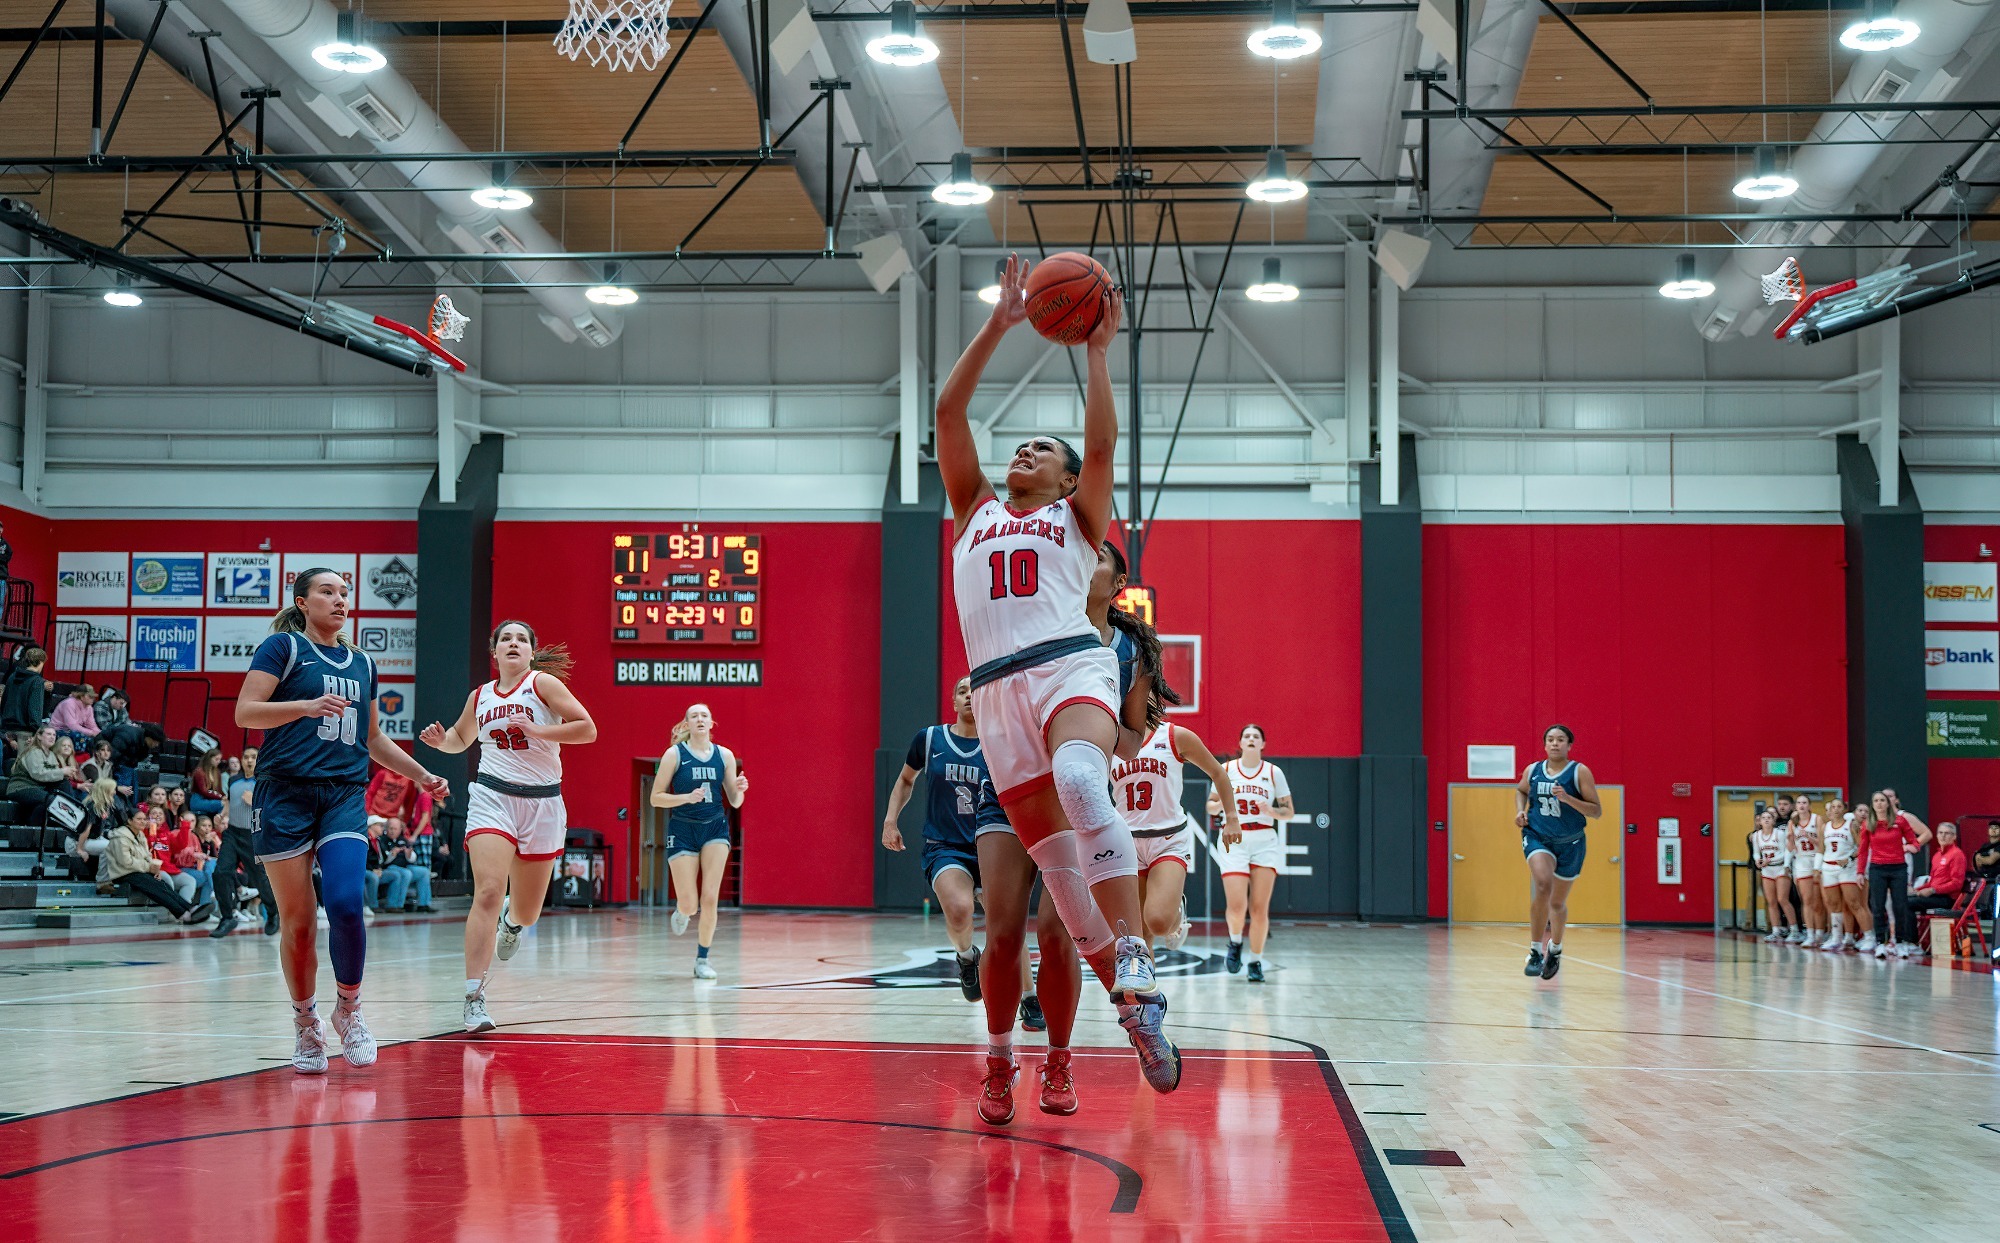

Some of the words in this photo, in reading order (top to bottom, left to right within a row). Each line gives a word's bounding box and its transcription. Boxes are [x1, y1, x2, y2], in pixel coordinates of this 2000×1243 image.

[969, 518, 1066, 553] RAIDERS
[669, 534, 719, 559] 9:31
[743, 550, 759, 575] 9
[76, 571, 125, 582] ROGUE
[217, 568, 262, 596] 12
[672, 574, 699, 586] period
[708, 569, 720, 588] 2
[989, 549, 1038, 600] 10
[622, 605, 635, 624] 0
[646, 607, 659, 624] 4
[712, 607, 725, 624] 4
[740, 606, 753, 625] 0
[138, 625, 195, 645] Flagship
[155, 644, 177, 660] Inn
[211, 644, 259, 656] PIZZ
[376, 659, 413, 667] KEMPER
[618, 662, 649, 682] BOB
[654, 663, 701, 682] RIEHM
[707, 663, 759, 683] ARENA
[323, 674, 361, 702] HIU
[317, 707, 357, 745] 30
[489, 726, 529, 750] 32
[692, 766, 717, 780] HIU
[945, 763, 979, 785] HIU
[955, 785, 974, 815] 2
[1125, 781, 1153, 811] 13
